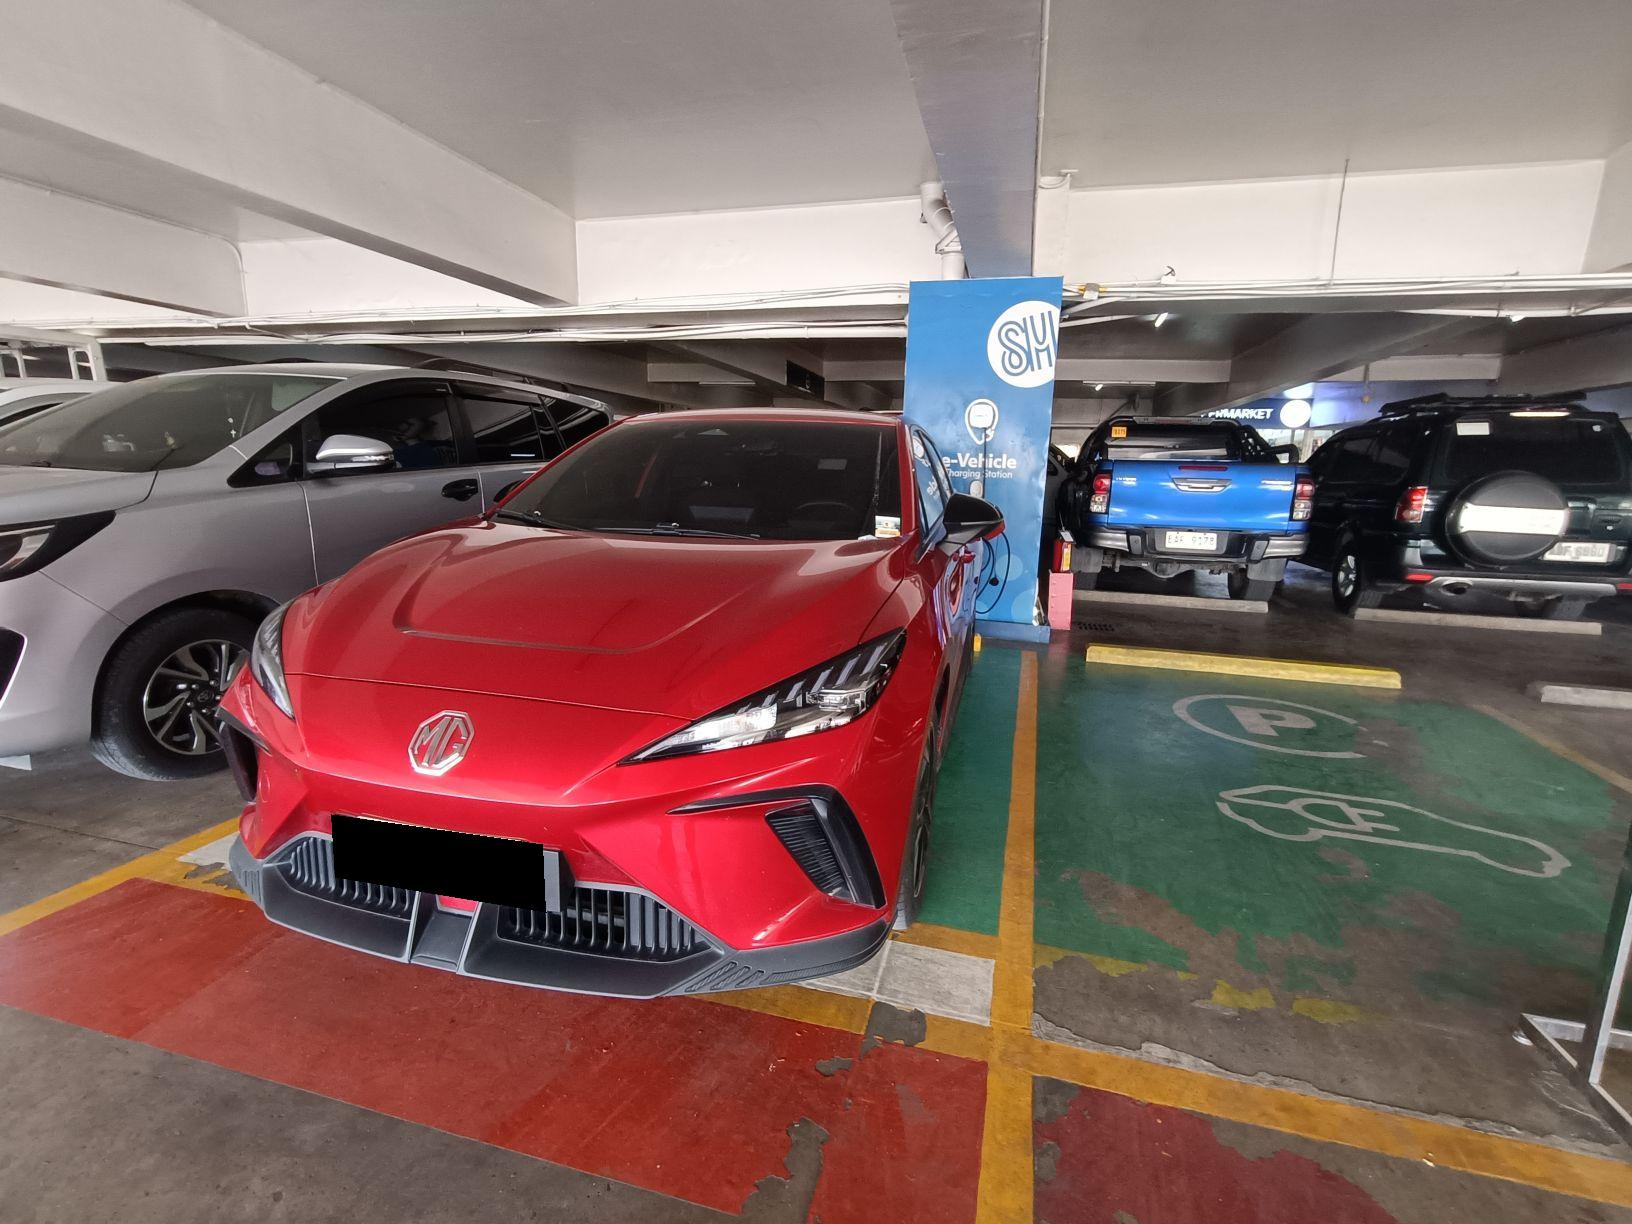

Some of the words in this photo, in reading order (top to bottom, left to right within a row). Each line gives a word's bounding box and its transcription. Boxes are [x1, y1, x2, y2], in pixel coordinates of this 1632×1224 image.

[997, 310, 1057, 376] SM
[1200, 408, 1274, 420] RMARKET
[942, 453, 1017, 469] e-Vehicle
[946, 469, 981, 480] harging
[414, 716, 469, 769] MG
